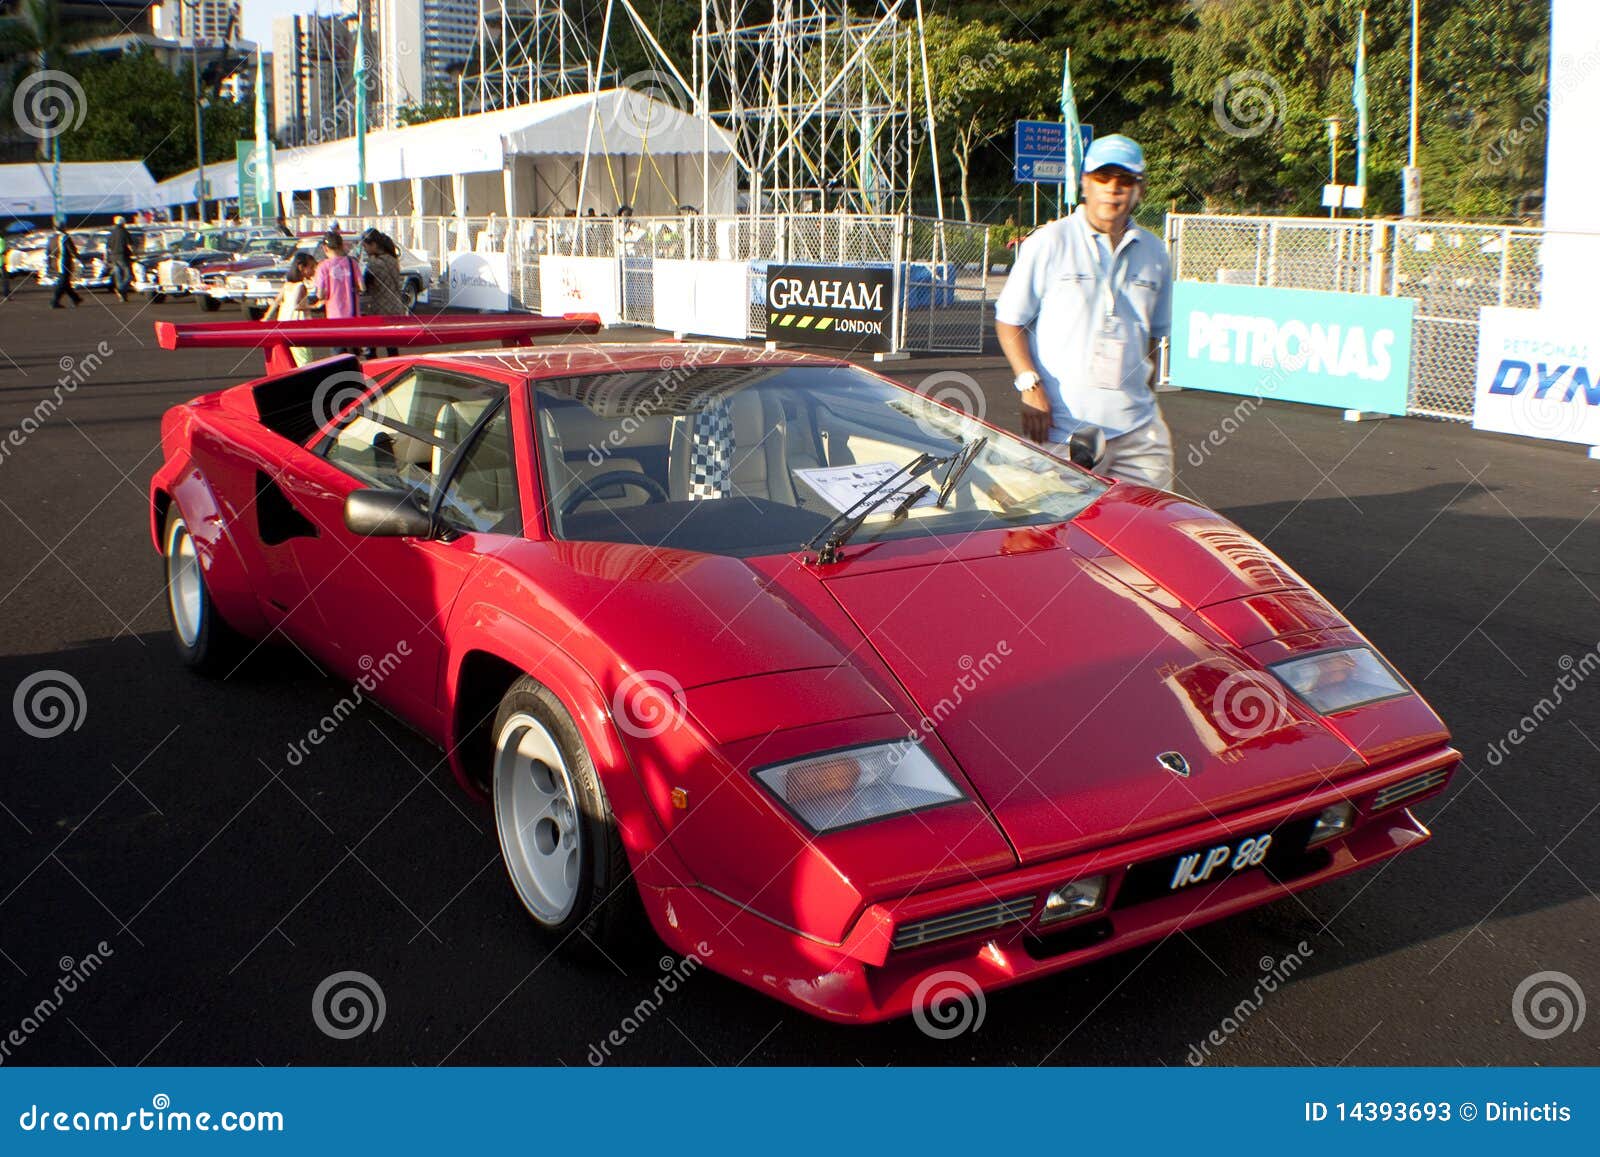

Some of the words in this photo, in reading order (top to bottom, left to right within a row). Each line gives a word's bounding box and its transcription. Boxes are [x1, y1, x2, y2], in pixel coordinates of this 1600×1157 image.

[770, 278, 884, 311] GRAHAM
[835, 319, 882, 335] LONDON
[1187, 310, 1395, 382] PETRONAS
[1170, 845, 1230, 889] WJP
[1231, 834, 1272, 870] 88
